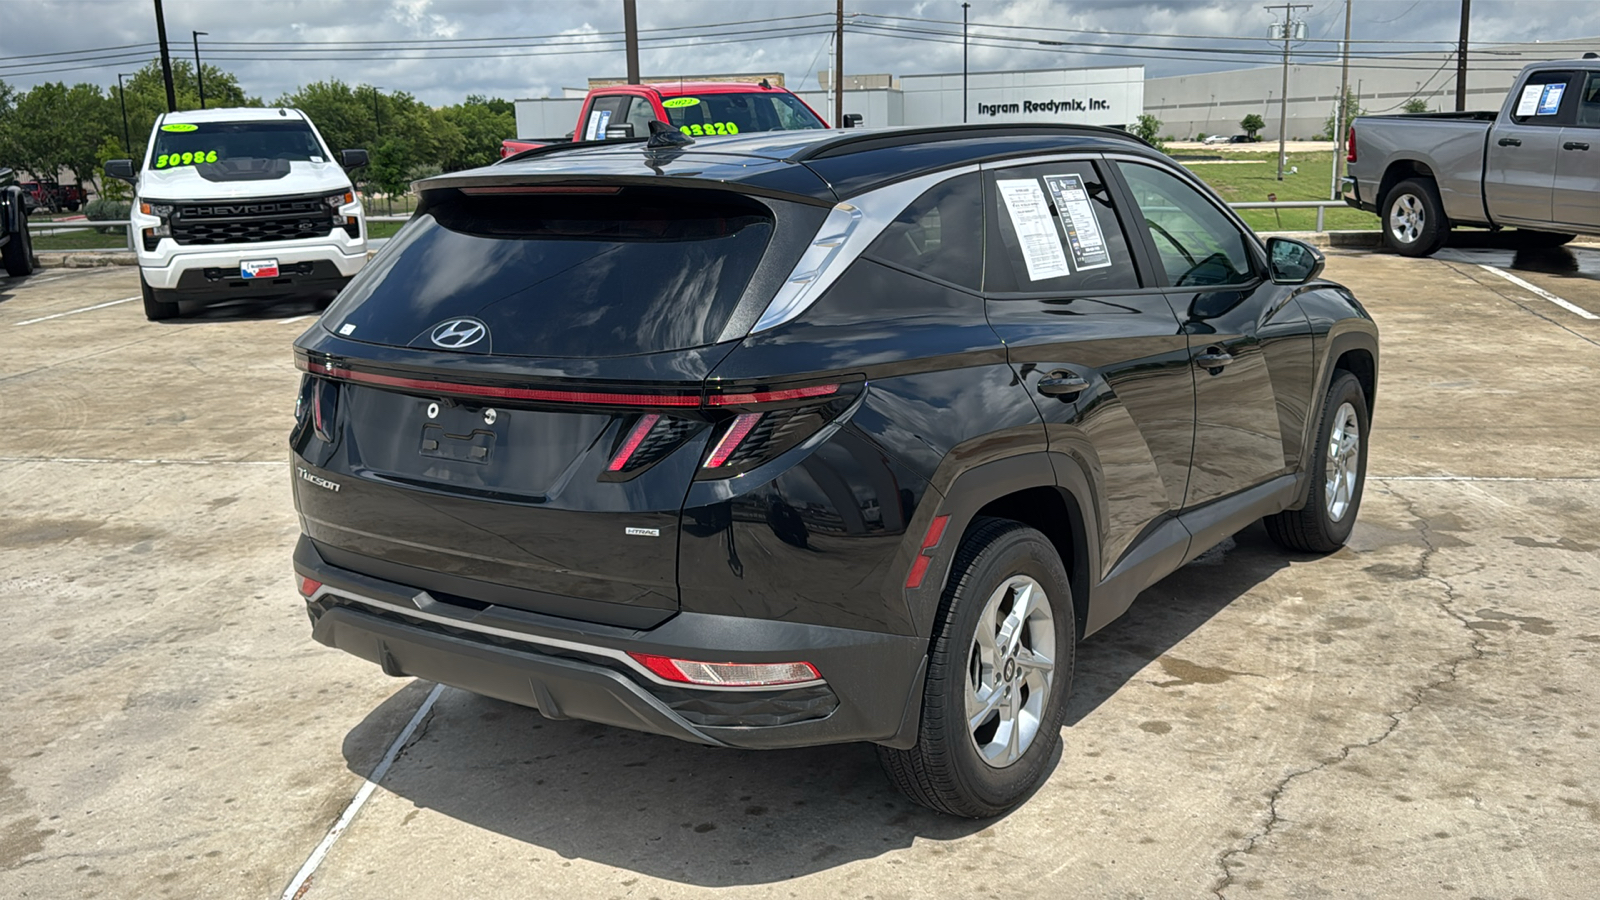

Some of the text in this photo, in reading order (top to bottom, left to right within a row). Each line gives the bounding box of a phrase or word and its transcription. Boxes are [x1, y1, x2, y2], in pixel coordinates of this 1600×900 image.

[978, 98, 1110, 116] Ingram Readymix, Inc.
[156, 150, 218, 168] 30986
[182, 201, 319, 216] CHEVROLET
[627, 528, 658, 536] HTRAC
